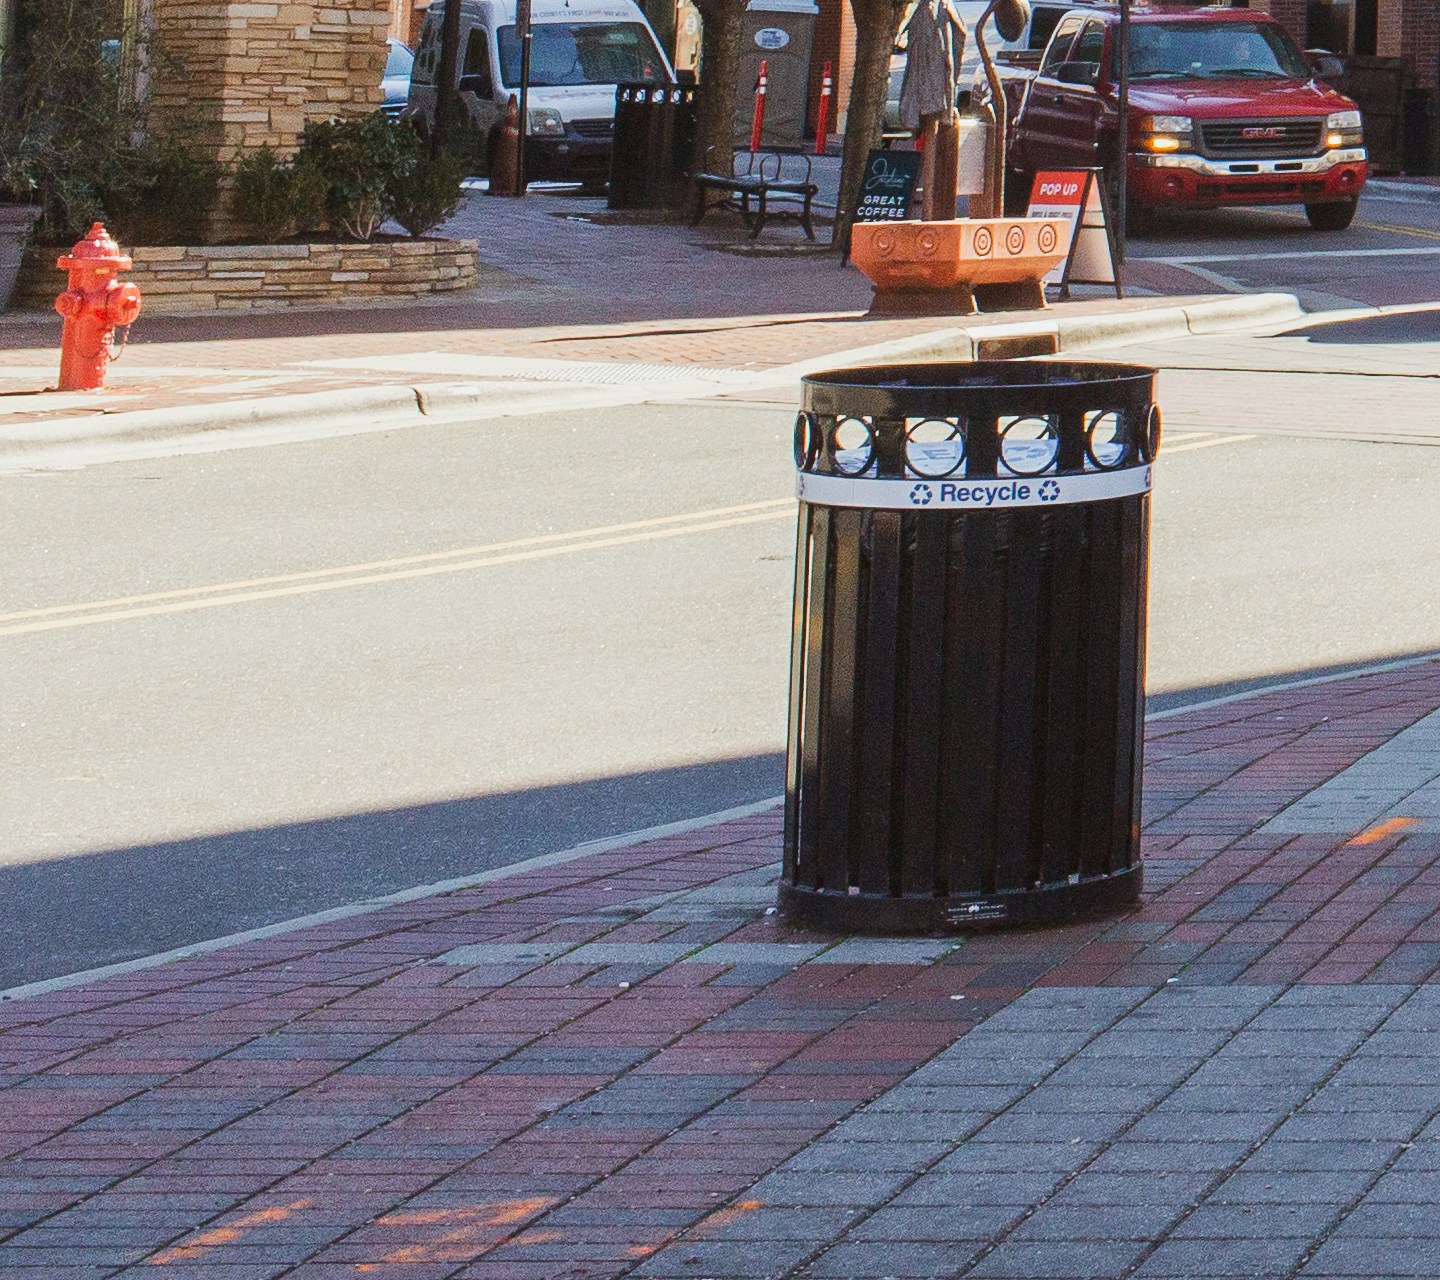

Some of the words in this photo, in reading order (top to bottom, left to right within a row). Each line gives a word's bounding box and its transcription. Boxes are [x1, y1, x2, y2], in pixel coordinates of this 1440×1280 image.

[1242, 127, 1286, 139] GMC
[1040, 183, 1062, 196] POP
[1063, 183, 1078, 196] UP
[863, 195, 905, 205] GREAT
[857, 206, 905, 217] COFFEE
[939, 481, 1031, 506] Recycle
